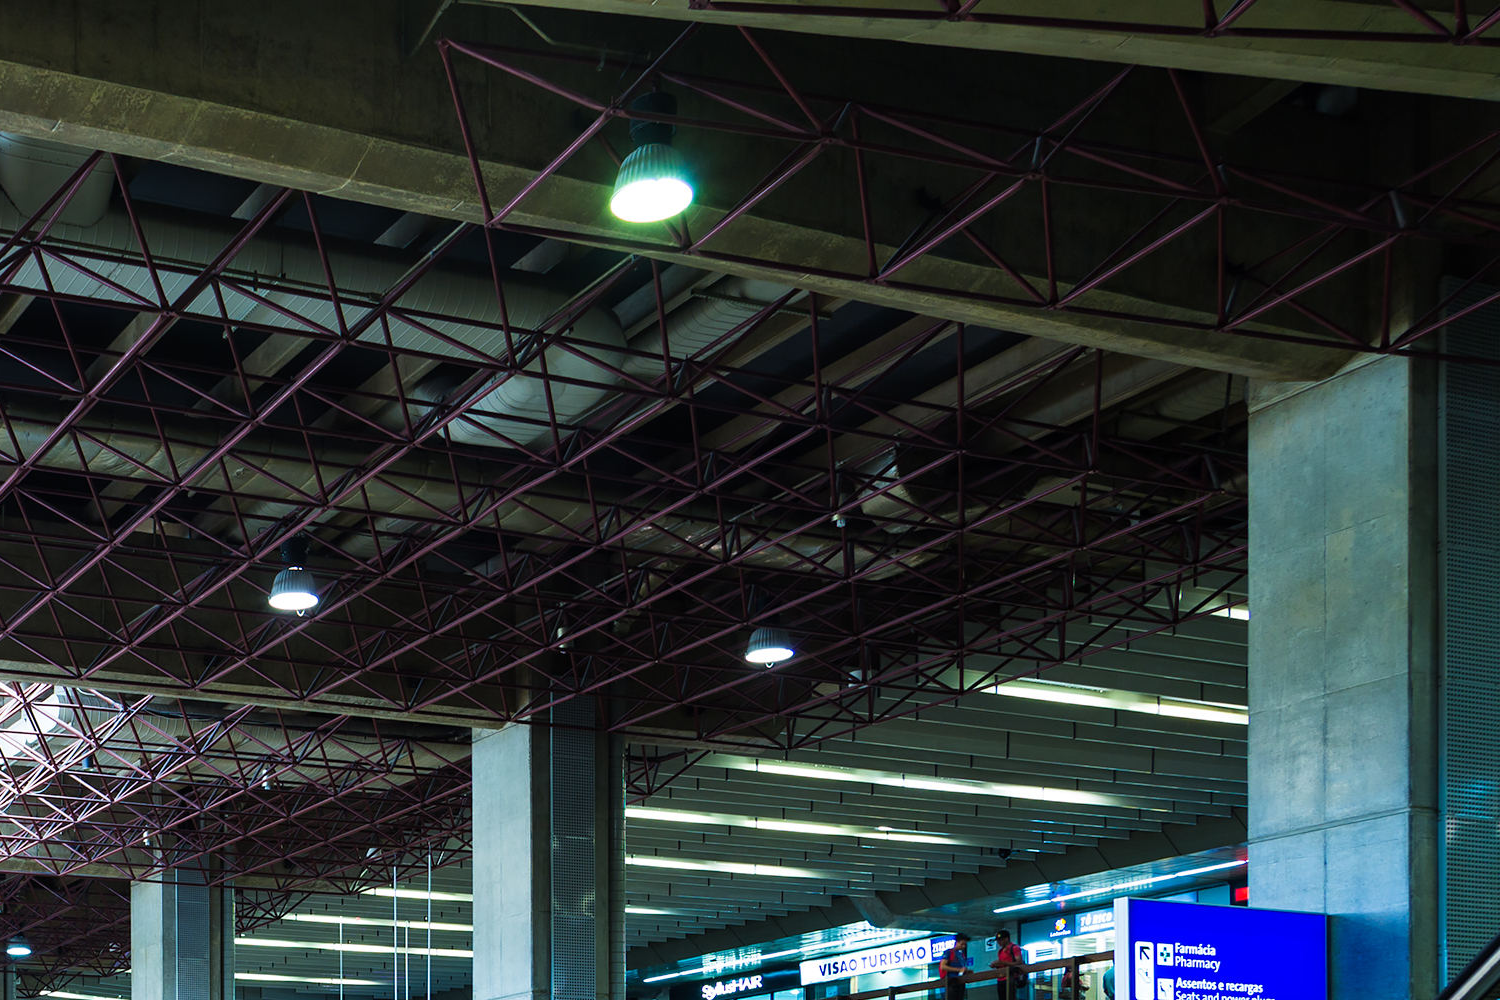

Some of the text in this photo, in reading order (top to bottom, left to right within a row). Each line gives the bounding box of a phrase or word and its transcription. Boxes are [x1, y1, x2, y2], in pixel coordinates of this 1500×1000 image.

[861, 946, 927, 969] TURISMO
[1175, 942, 1216, 956] Farmácia
[1175, 956, 1221, 973] Pharmacy
[1176, 977, 1263, 995] Assentos e recargas
